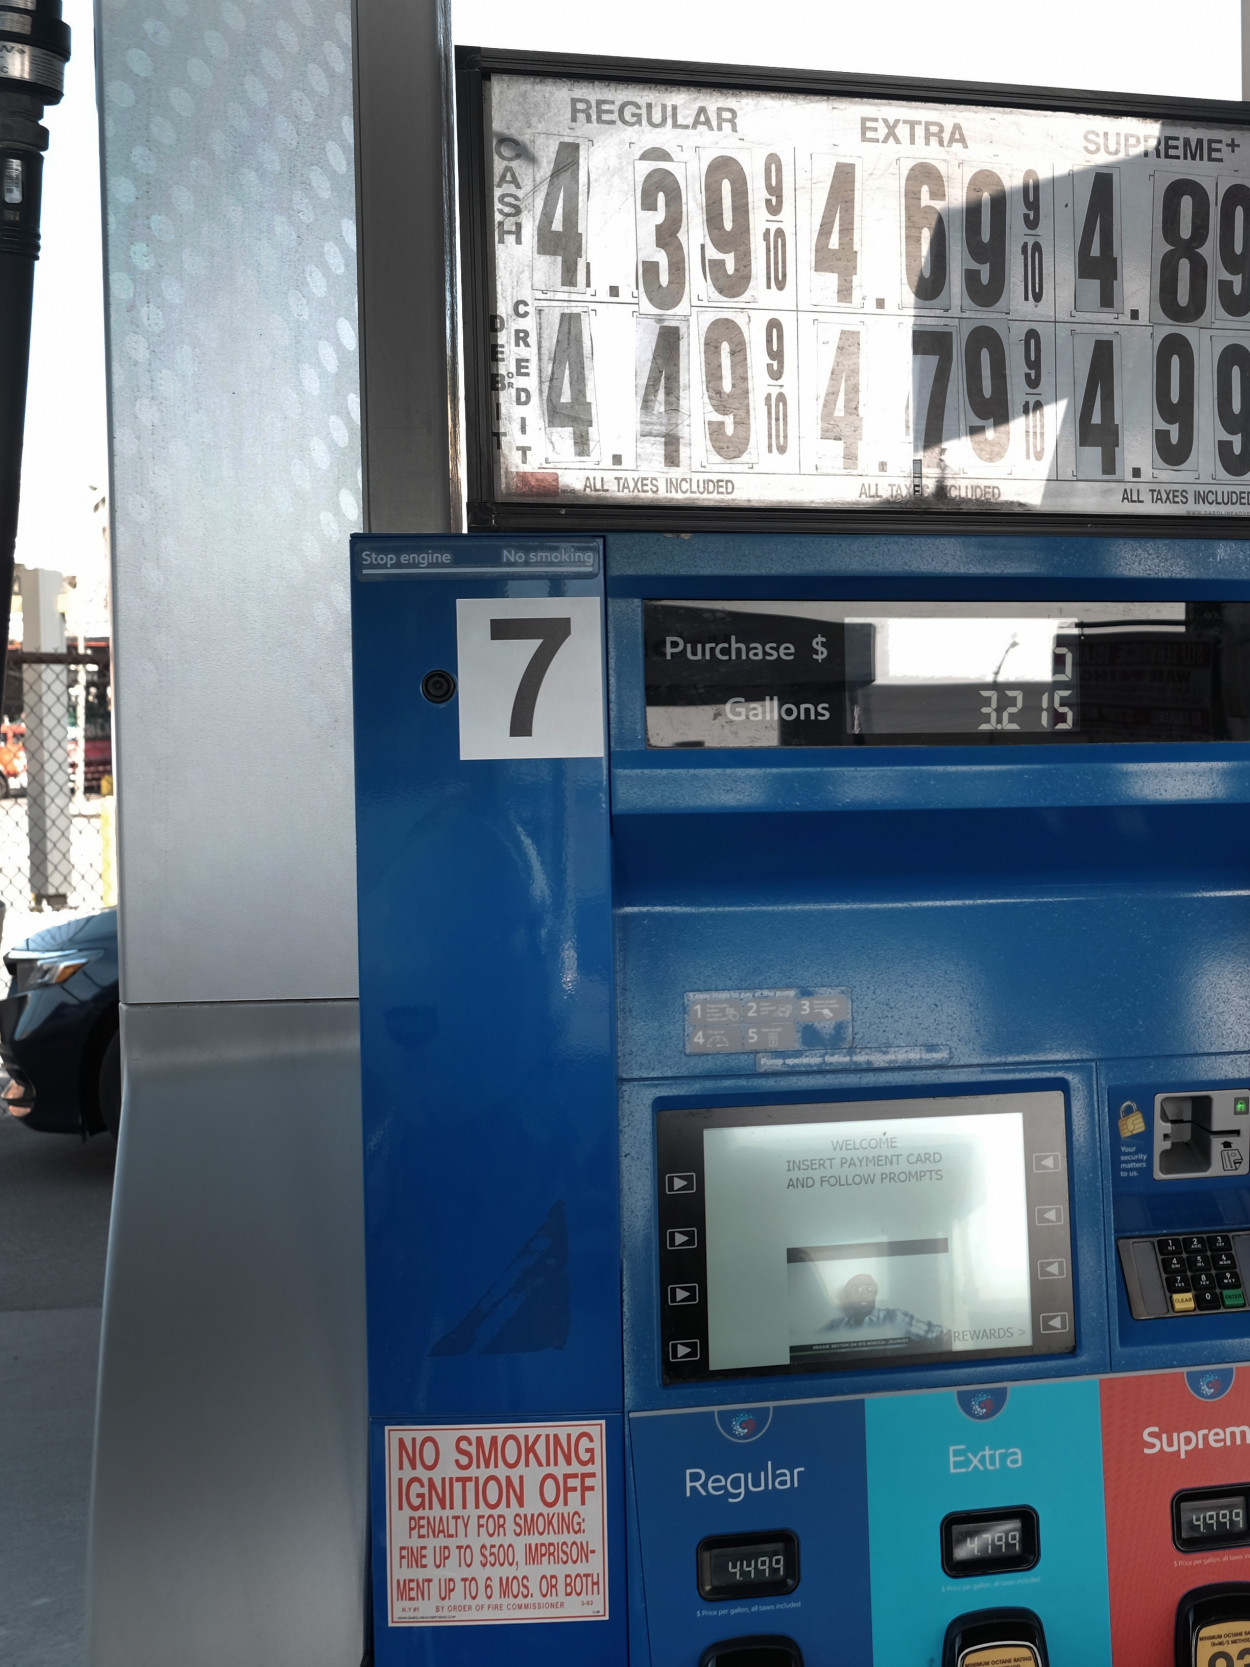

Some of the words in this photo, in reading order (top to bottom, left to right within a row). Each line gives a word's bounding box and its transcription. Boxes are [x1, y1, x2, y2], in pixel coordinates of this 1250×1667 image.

[571, 97, 738, 133] REGULAR
[859, 117, 969, 149] EXTRA
[1083, 129, 1241, 162] SUPREME+
[494, 137, 522, 246] CASH
[536, 141, 752, 311] 4.39
[814, 162, 1007, 309] 4.69
[490, 315, 507, 450] DEBIT
[513, 299, 532, 464] CREDIT
[546, 313, 752, 468] 4.49
[819, 325, 1010, 472] 4.79
[583, 476, 612, 493] ALL
[615, 477, 659, 495] TAXES
[665, 478, 735, 496] INCLUDED
[859, 483, 882, 498] ALL
[938, 484, 1001, 500] CLUDED
[1121, 488, 1146, 504] ALL
[1149, 489, 1189, 505] TAXES
[362, 551, 396, 567] Stop
[400, 550, 451, 567] engine
[503, 549, 525, 563] No
[529, 549, 594, 565] smoking
[666, 635, 795, 662] Purchase
[811, 634, 828, 664] $
[489, 616, 572, 737] 7
[725, 697, 830, 722] Gallons
[977, 690, 1074, 730] 3.215
[693, 1004, 702, 1018] 1
[747, 1002, 757, 1016] 2
[800, 1001, 810, 1014] 3
[693, 1031, 704, 1045] 4
[748, 1029, 757, 1042] 5
[831, 1136, 898, 1152] WELCOME
[786, 1157, 835, 1173] INSERT
[839, 1154, 903, 1170] PAYMENT
[906, 1151, 943, 1167] CARD
[1120, 1153, 1147, 1161] security
[786, 1174, 816, 1190] AND
[819, 1172, 876, 1188] FOLLOW
[880, 1169, 944, 1186] PROMPTS
[953, 1327, 1014, 1343] REWARDS
[398, 1436, 441, 1471] NO
[454, 1431, 596, 1471] SMOKING
[949, 1444, 1023, 1474] Extra
[397, 1474, 525, 1512] IGNITION
[538, 1471, 597, 1508] OFF
[685, 1460, 805, 1503] Regular
[408, 1515, 471, 1539] PENALTY
[477, 1513, 507, 1538] FOR
[513, 1511, 585, 1537] SMOKING:
[1192, 1508, 1243, 1533] 4.999
[399, 1545, 427, 1569] FINE
[433, 1545, 451, 1569] UP
[456, 1544, 474, 1568] TO
[479, 1542, 519, 1571] $500,
[524, 1541, 596, 1566] IMPRISON-
[728, 1555, 784, 1581] 4.499
[396, 1577, 433, 1602] MENT
[438, 1577, 456, 1601] UP
[461, 1576, 478, 1601] TO
[484, 1575, 494, 1599] 6
[499, 1574, 534, 1600] MOS.
[539, 1574, 559, 1598] OR
[564, 1572, 600, 1597] BOTH
[435, 1605, 445, 1613] BY
[447, 1604, 473, 1612] ORDER
[475, 1603, 485, 1611] OF
[487, 1603, 504, 1611] FIRE
[506, 1601, 565, 1611] COMMISSIONER
[718, 1608, 729, 1616] per
[729, 1606, 750, 1615] gallon,
[775, 1601, 801, 1609] included
[1199, 1634, 1223, 1642] MINIMUM
[1223, 1631, 1244, 1639] OCTANE
[991, 1657, 1012, 1665] OCTANE
[1013, 1655, 1032, 1663] RATING
